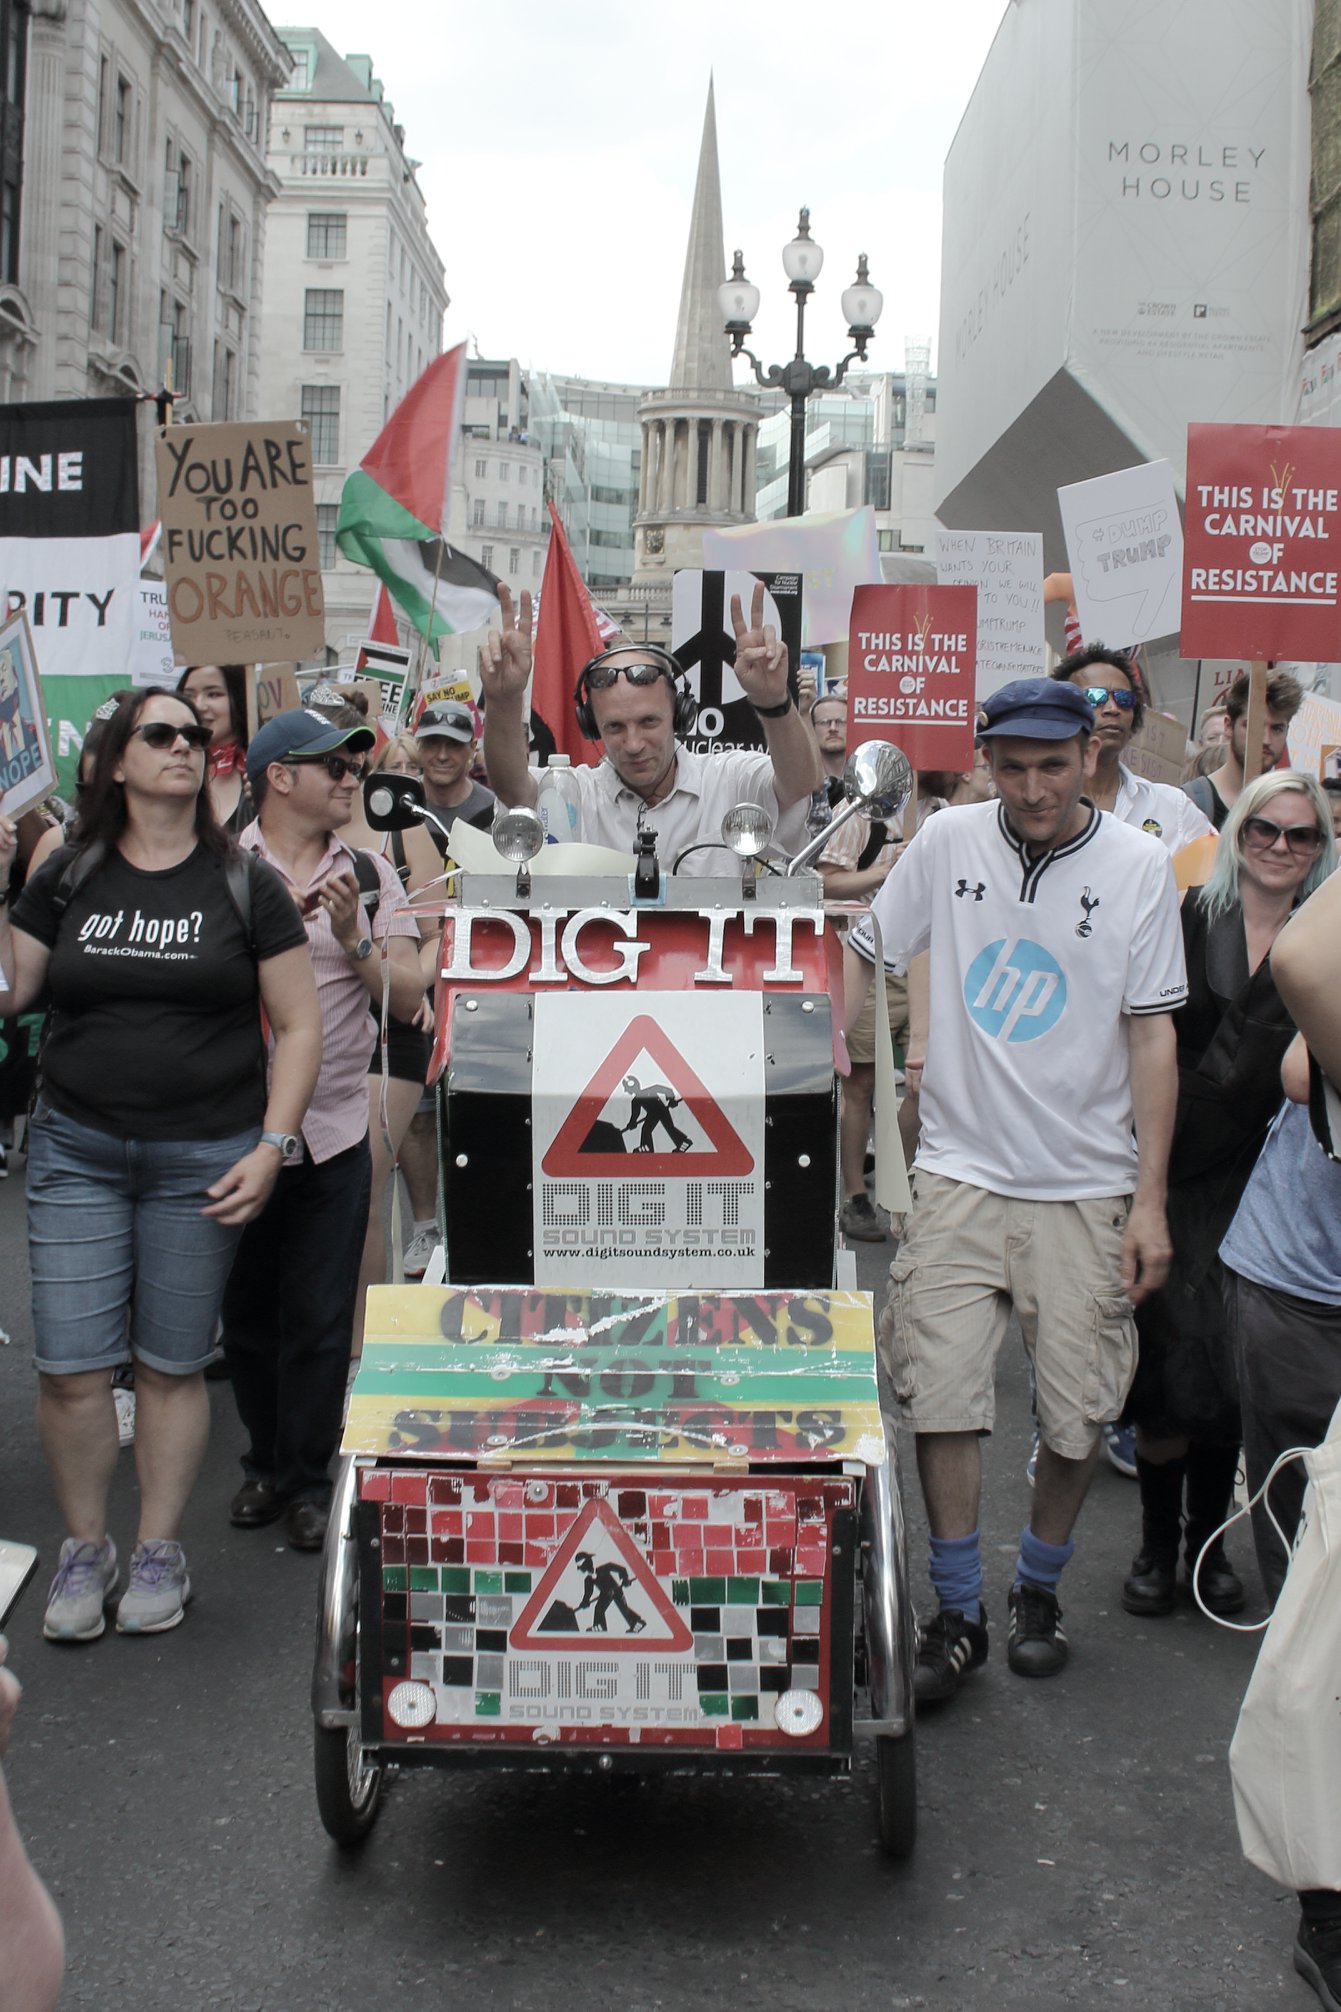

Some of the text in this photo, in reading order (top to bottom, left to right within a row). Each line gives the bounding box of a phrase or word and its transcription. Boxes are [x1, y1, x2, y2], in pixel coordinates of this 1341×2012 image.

[1108, 141, 1266, 169] MORLEY
[1121, 176, 1251, 203] HOUSE
[0, 451, 84, 494] INE
[167, 438, 310, 497] YOU ARE
[200, 496, 259, 522] TOO
[1197, 485, 1338, 511] THIS IS THE
[1204, 513, 1330, 539] CARNIVAL
[168, 523, 307, 564] FUCKING
[939, 537, 1037, 557] WHEN BRITAIN
[1097, 534, 1172, 573] TRUMP
[1249, 541, 1285, 565] OF
[940, 560, 1016, 575] WANTS YOUR
[999, 580, 1013, 590] WE
[1018, 580, 1038, 593] WILL
[1191, 568, 1338, 594] RESISTANCE
[140, 592, 168, 605] TRU
[169, 569, 323, 624] ORANGE
[983, 592, 999, 605] TO
[149, 609, 169, 619] HAN
[140, 630, 171, 642] JERUSA
[158, 622, 170, 631] OF
[858, 632, 967, 652] THIS IS THE
[864, 654, 961, 673] CARNIVAL
[899, 675, 926, 695] OF
[1214, 668, 1245, 686] LIA
[427, 687, 456, 703] SAY NO
[854, 697, 969, 717] RESISTANCE
[684, 737, 744, 755] uclear
[77, 909, 203, 950] got hope?
[83, 944, 190, 960] BarackObama.com
[441, 907, 825, 984] DIG IT
[963, 938, 1067, 1043] hp
[543, 1182, 754, 1225] DIG IT
[543, 1228, 756, 1245] SOUND SYSTEM
[544, 1247, 756, 1260] www.digitsoundsystem.co.uk
[439, 1291, 835, 1348] CITIZENS
[536, 1356, 713, 1399] NOT
[388, 1408, 847, 1452] SUBJECTS
[509, 1660, 697, 1700] DIG IT
[509, 1704, 698, 1721] SOUND SYSTEM
